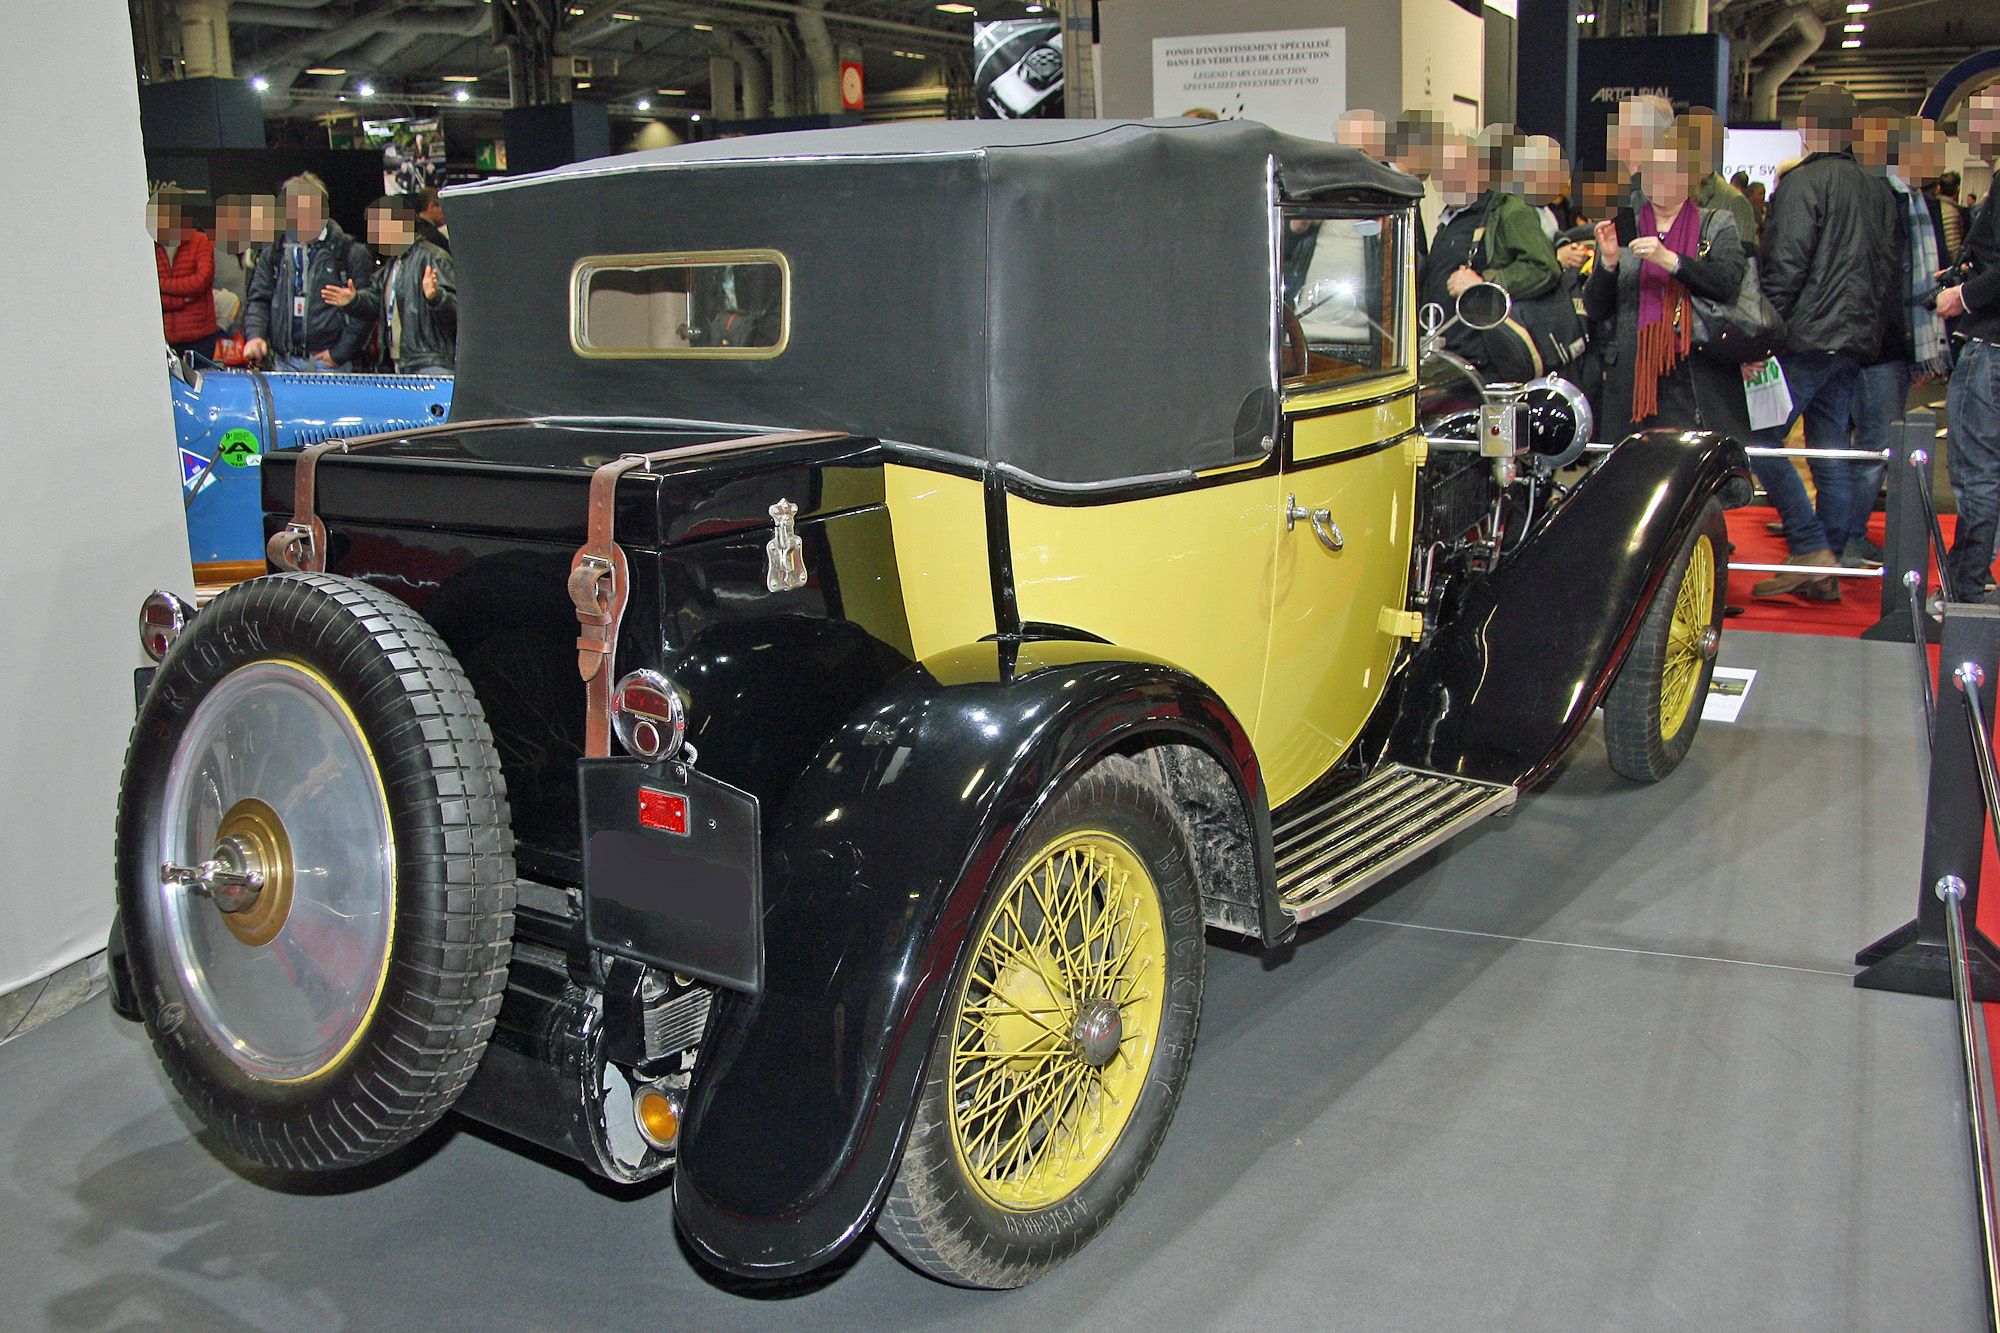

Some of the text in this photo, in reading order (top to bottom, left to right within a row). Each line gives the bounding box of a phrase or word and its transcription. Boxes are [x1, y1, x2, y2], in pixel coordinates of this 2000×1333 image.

[1165, 48, 1194, 56] FONDS
[1191, 58, 1206, 66] LES
[1259, 54, 1270, 62] DE
[1272, 51, 1330, 61] COLLECTION
[1193, 71, 1228, 80] LEGEND
[1252, 66, 1307, 76] COLLECTION
[1239, 78, 1293, 88] INVESTMENT
[1294, 77, 1320, 85] FUND
[1153, 846, 1197, 1095] BLOCKLEY
